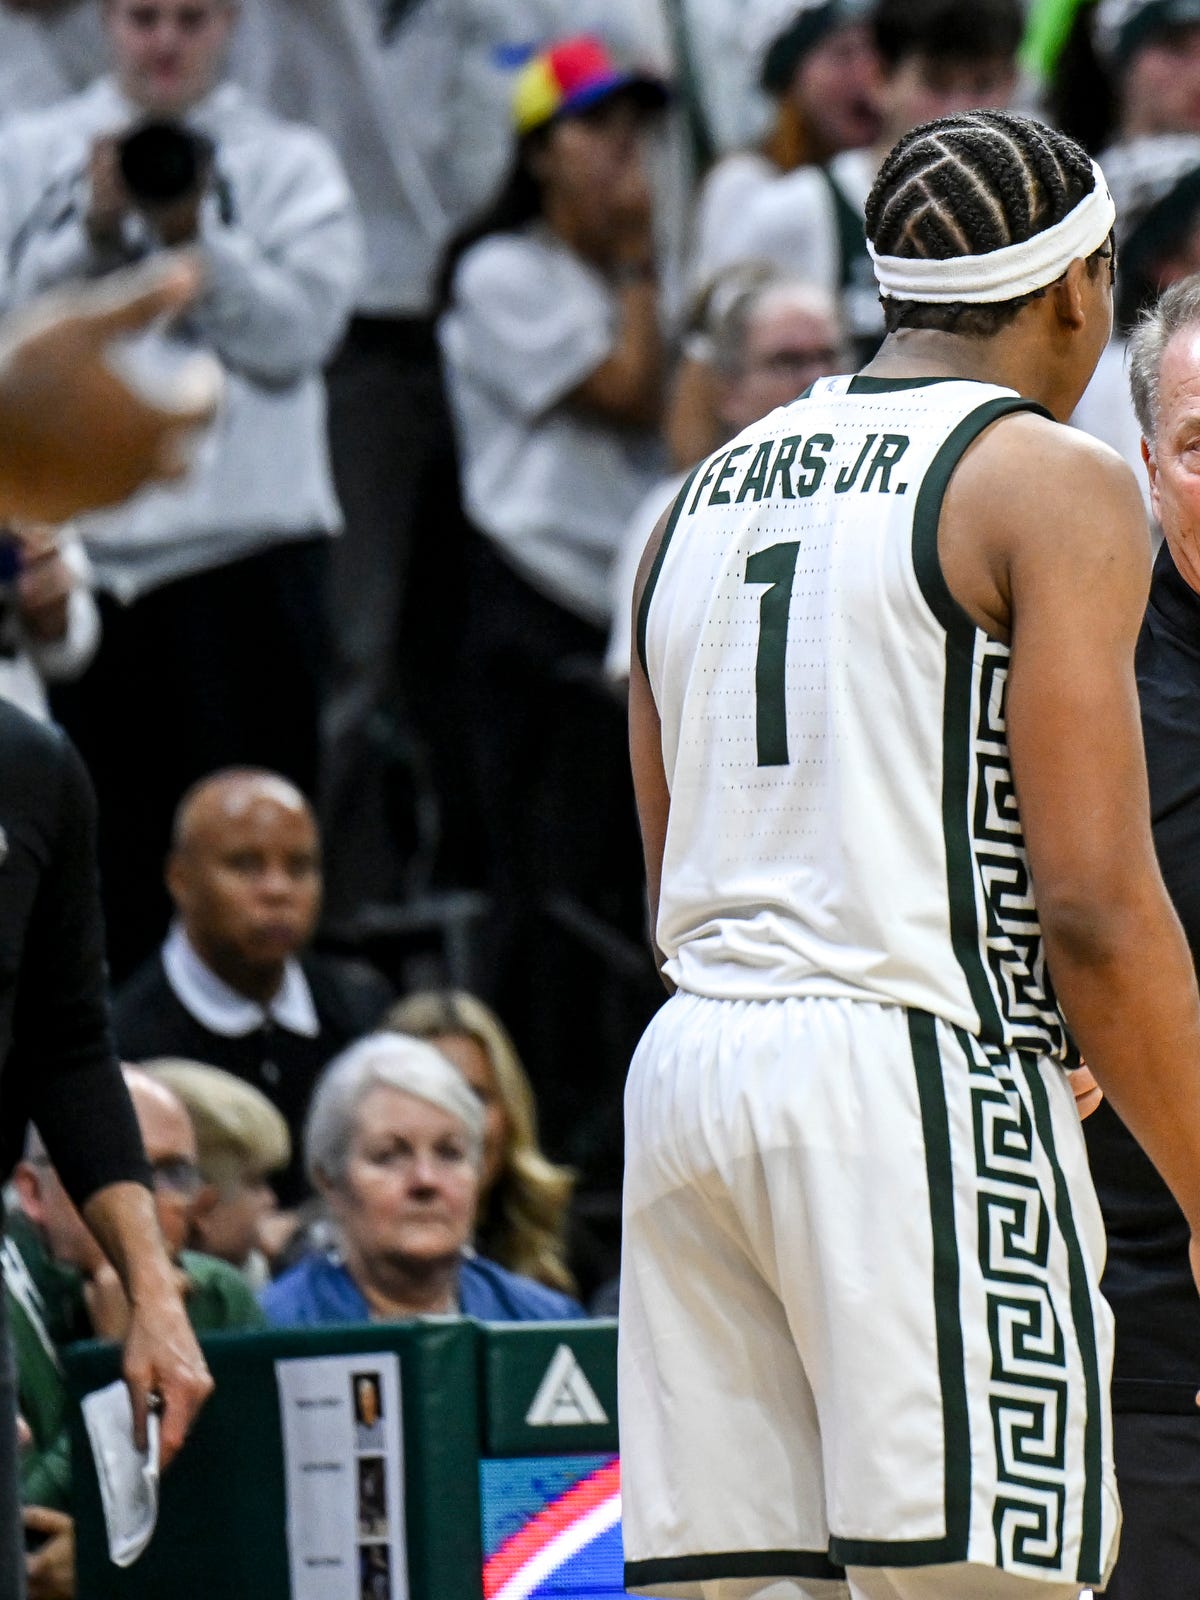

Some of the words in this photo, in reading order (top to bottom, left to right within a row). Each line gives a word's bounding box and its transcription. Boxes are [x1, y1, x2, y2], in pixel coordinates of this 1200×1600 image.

[688, 433, 835, 515] FEARS
[834, 433, 910, 494] JR.
[744, 541, 801, 767] 1
